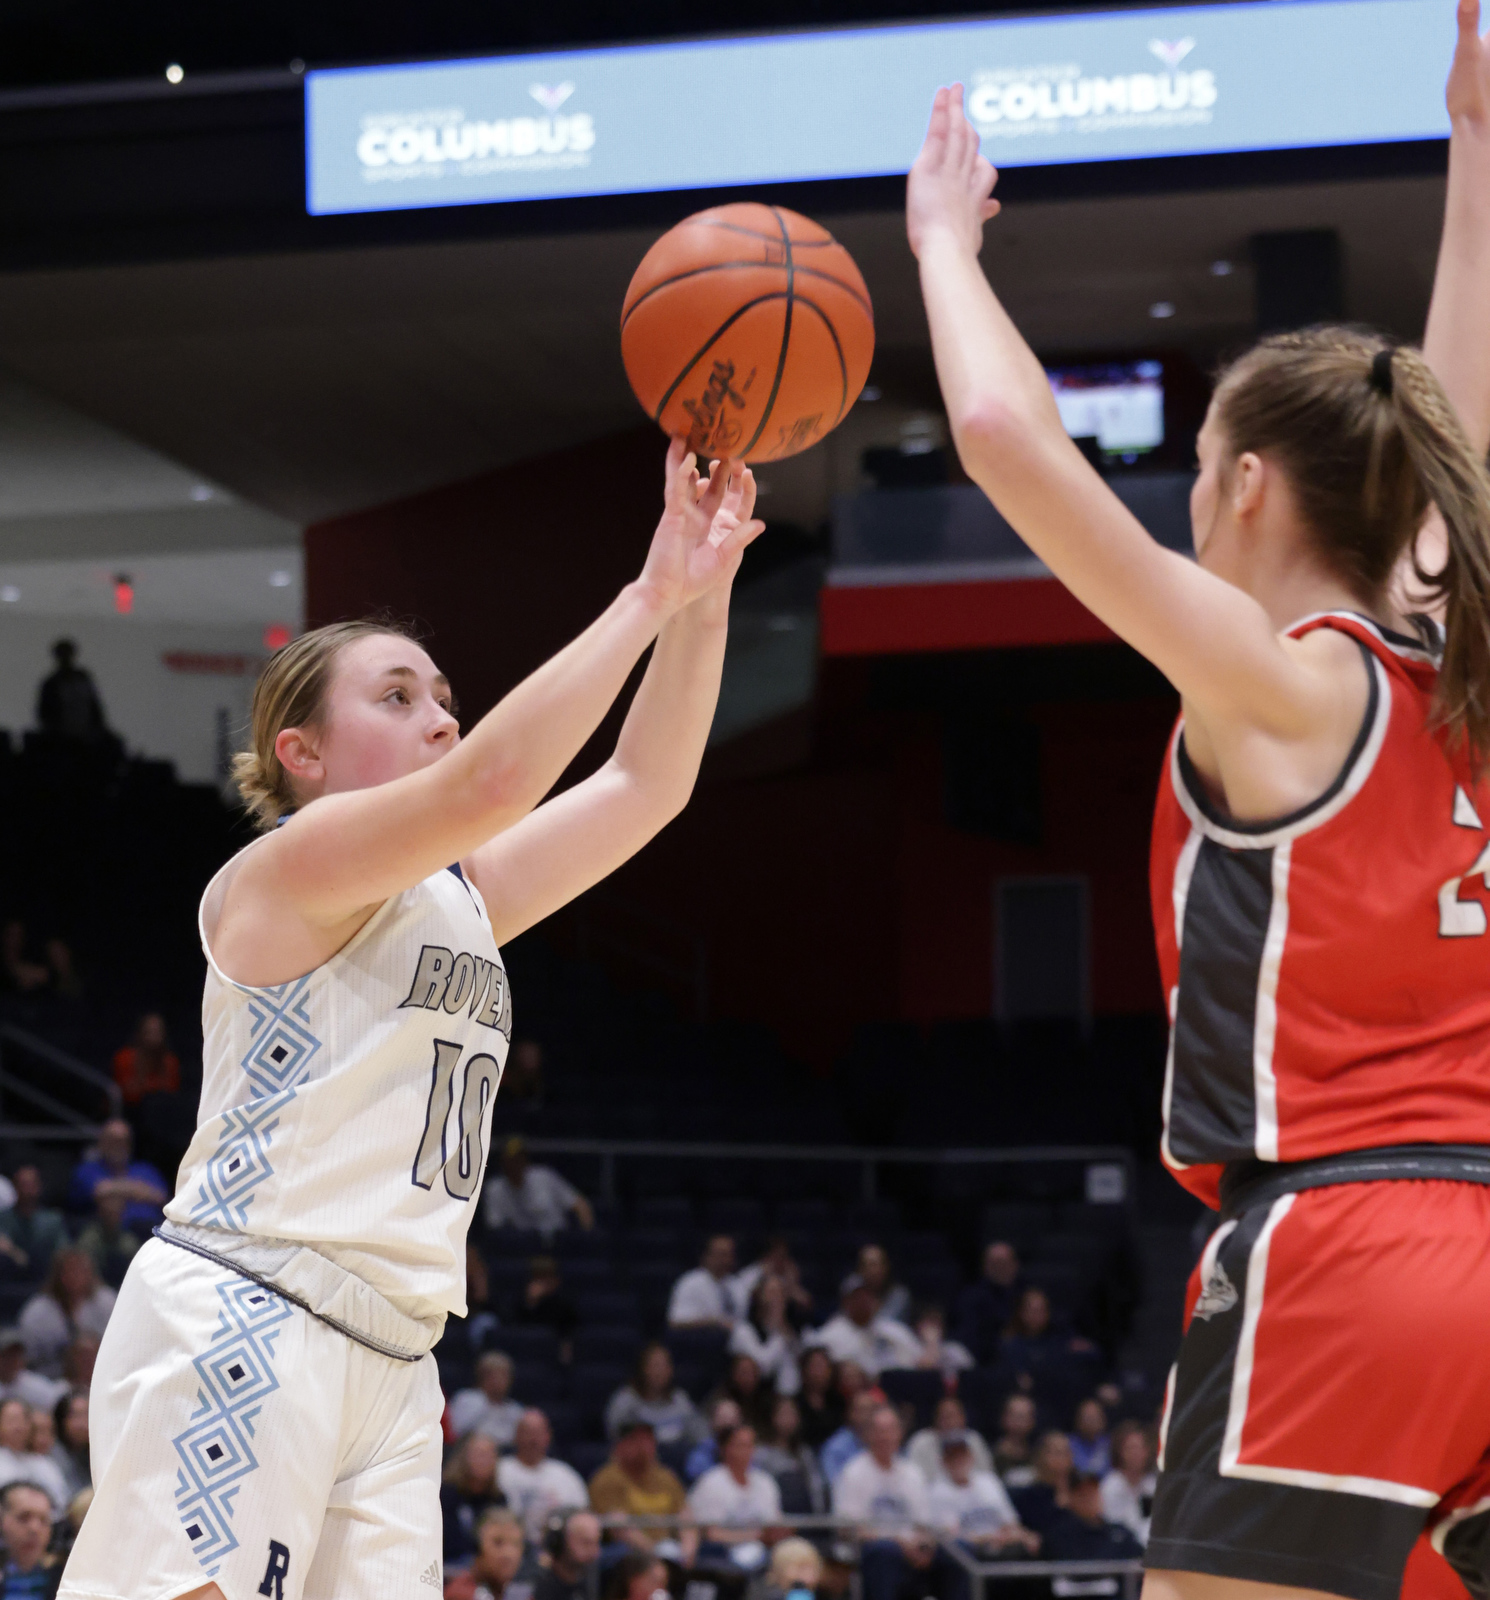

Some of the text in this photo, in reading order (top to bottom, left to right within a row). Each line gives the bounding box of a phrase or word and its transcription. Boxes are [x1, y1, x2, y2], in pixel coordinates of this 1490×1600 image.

[969, 70, 1217, 122] COLUMBUS
[357, 113, 596, 167] COLUMBUS
[412, 1038, 500, 1201] 10
[257, 1538, 290, 1600] R
